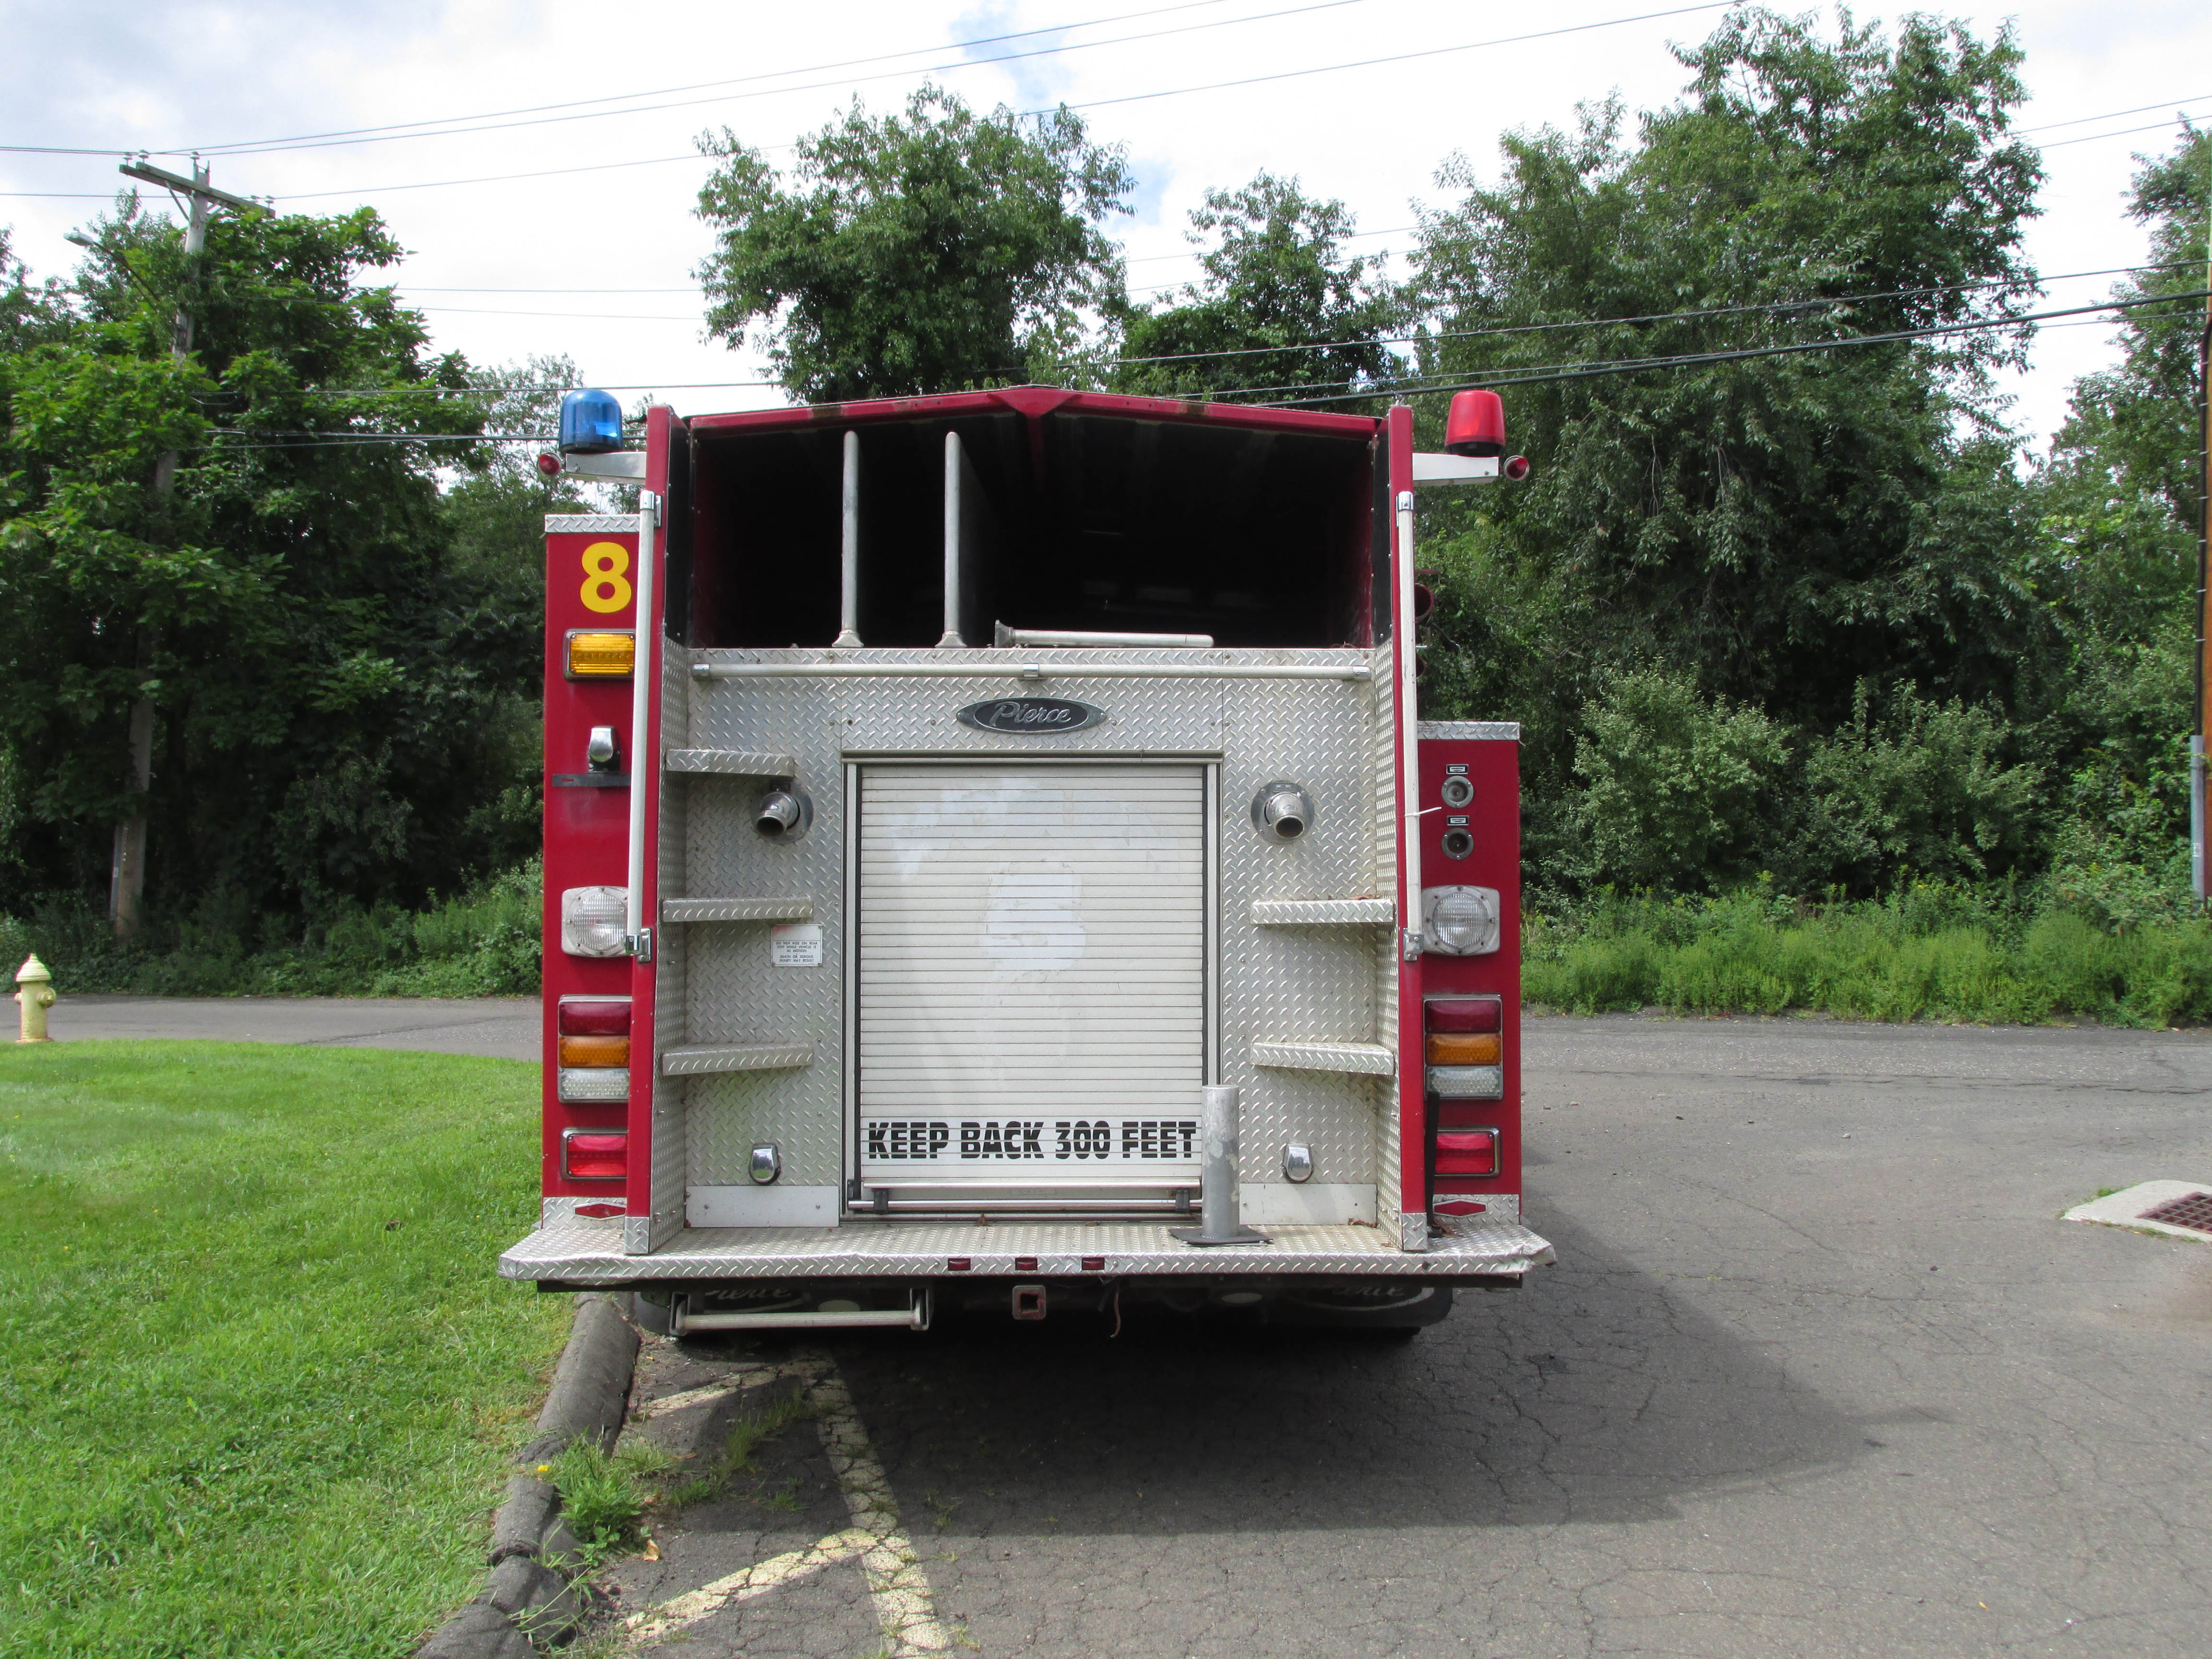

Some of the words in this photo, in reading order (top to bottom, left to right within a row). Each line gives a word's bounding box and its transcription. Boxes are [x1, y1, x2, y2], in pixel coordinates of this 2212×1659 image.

[579, 542, 632, 613] 8
[989, 701, 1071, 726] Pierce
[868, 1122, 949, 1159] KEEP
[961, 1121, 1045, 1159] BACK
[1055, 1120, 1111, 1160] 300
[1122, 1121, 1197, 1158] FEET
